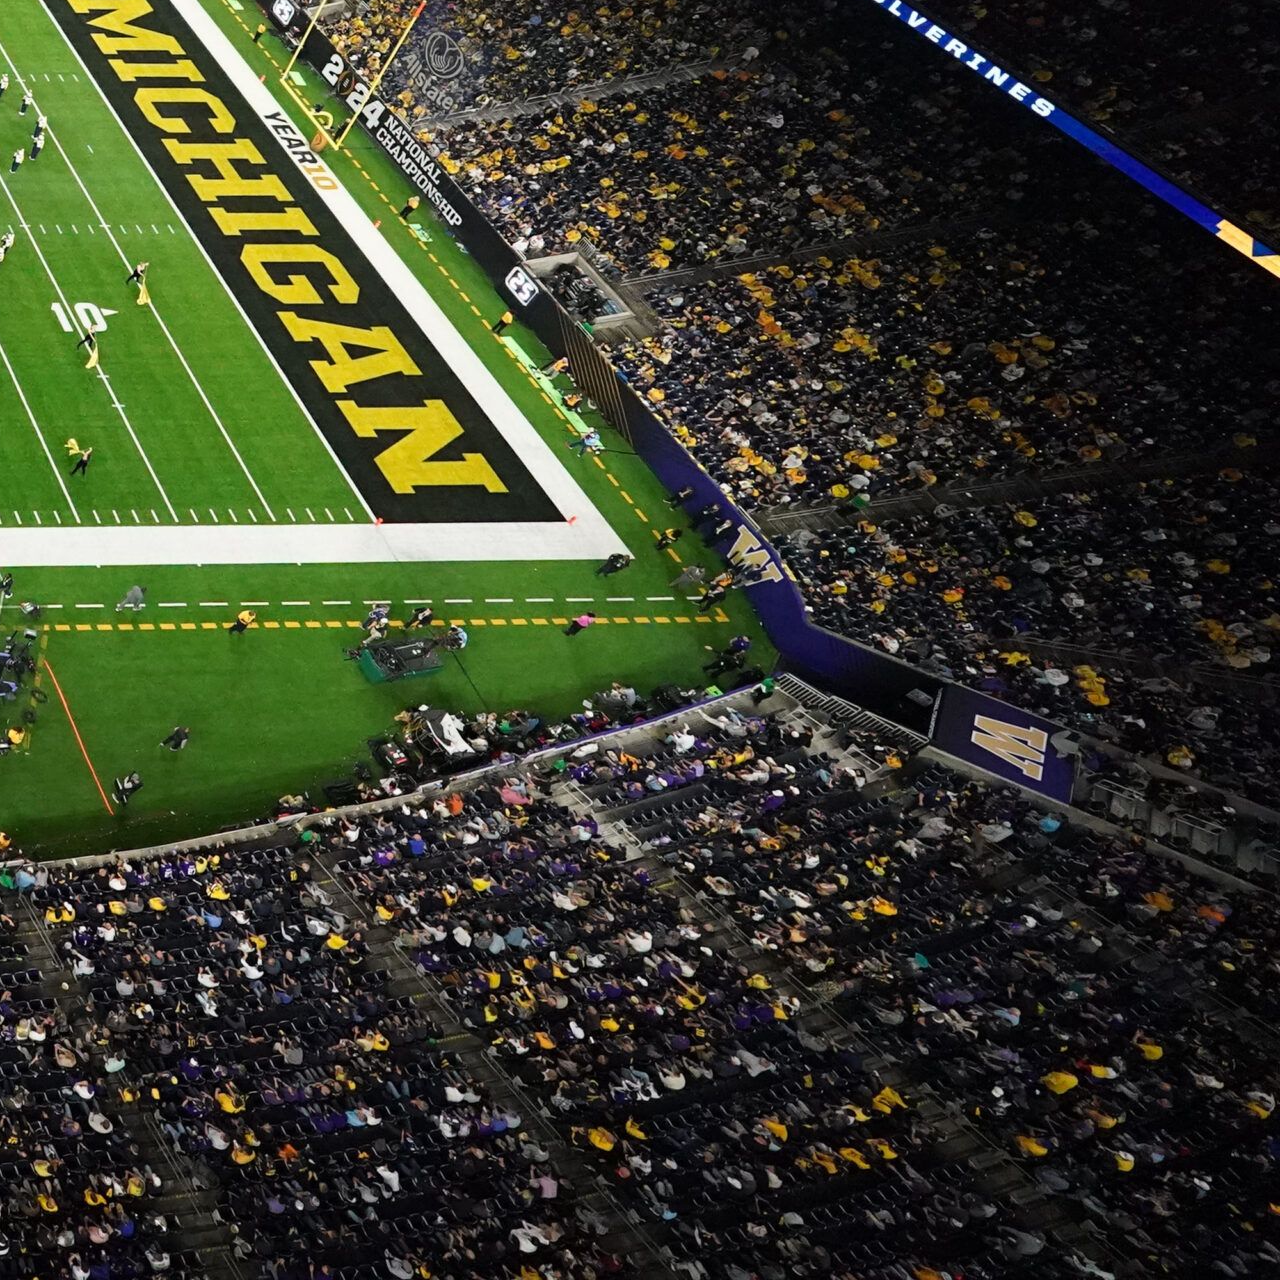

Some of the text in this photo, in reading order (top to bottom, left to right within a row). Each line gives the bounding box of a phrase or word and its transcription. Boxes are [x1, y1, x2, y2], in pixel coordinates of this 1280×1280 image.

[403, 51, 452, 107] Allstate
[375, 128, 463, 227] CHAMPIONSHIP
[383, 115, 441, 186] NATIONAL
[51, 302, 109, 333] 10
[971, 714, 1048, 782] W
